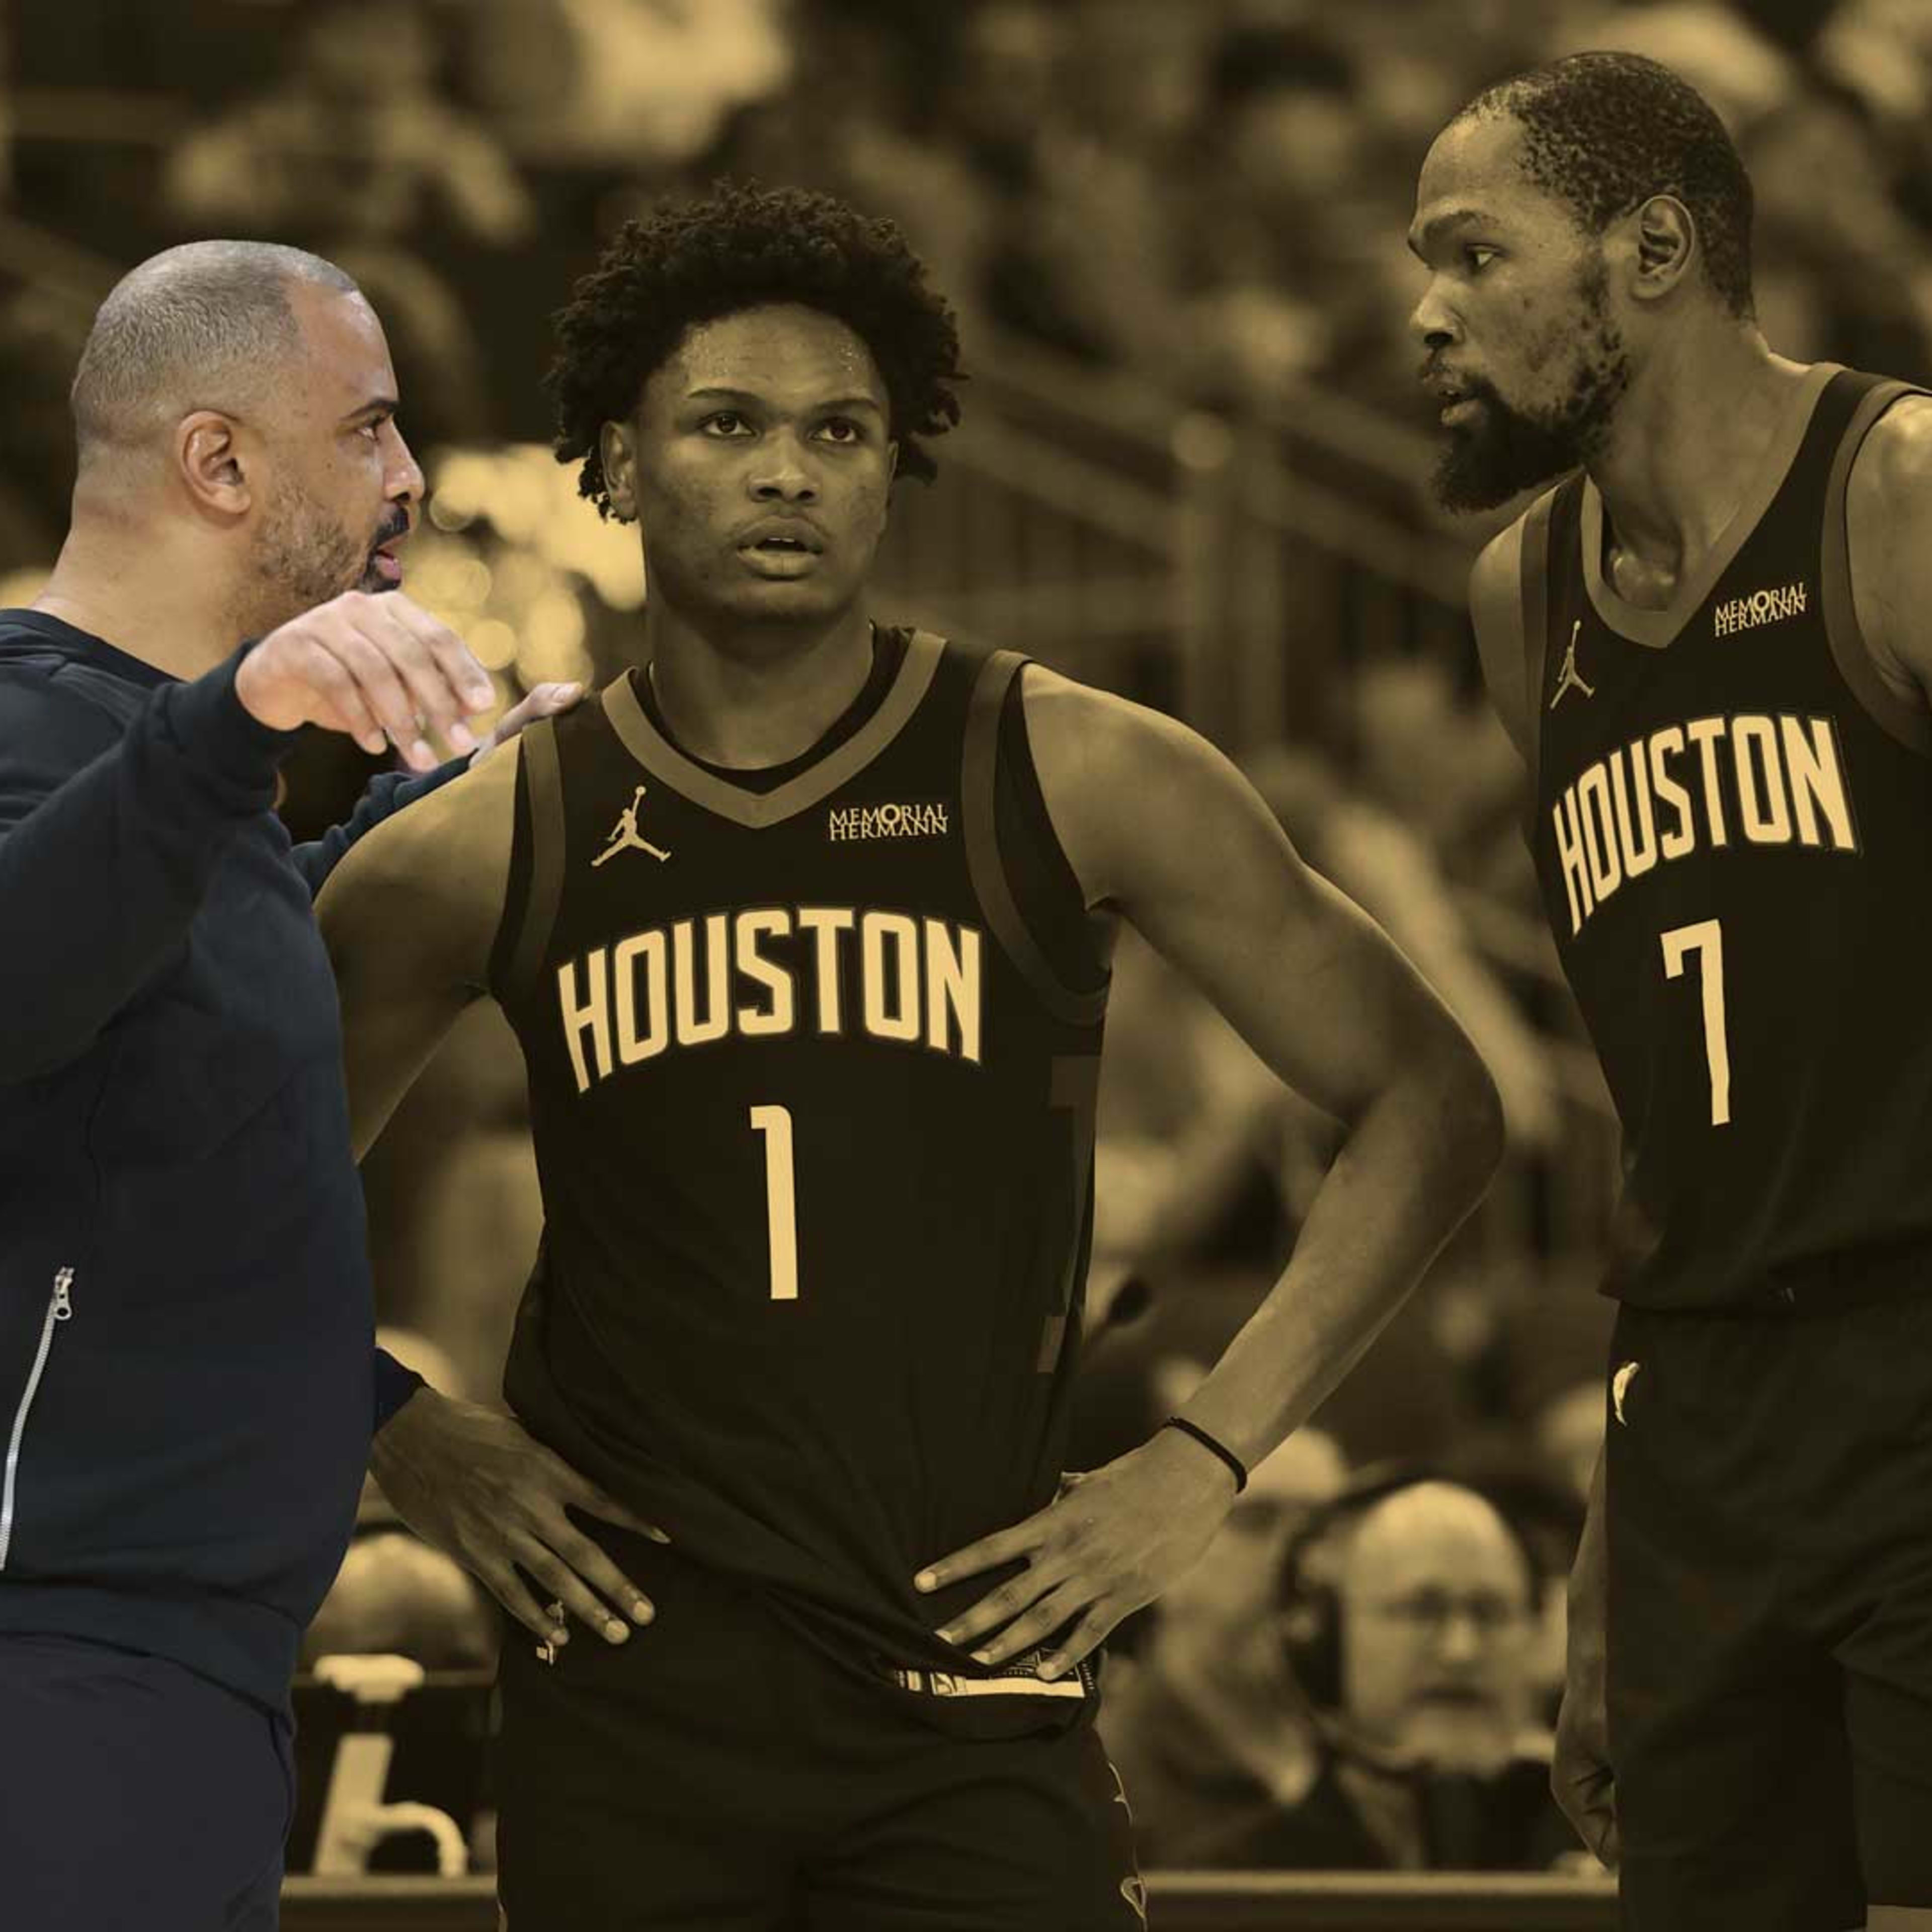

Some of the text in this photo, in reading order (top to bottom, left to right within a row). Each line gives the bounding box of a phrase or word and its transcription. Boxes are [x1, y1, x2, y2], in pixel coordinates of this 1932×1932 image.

[1715, 582, 1807, 620] MEMORIAL
[1715, 597, 1806, 637] HERMANN
[830, 803, 948, 826] MEMORIAL
[830, 818, 947, 841] HERMANN
[1553, 715, 1855, 937] HOUSTON
[557, 907, 982, 1093] HOUSTON
[1661, 919, 1730, 1126] 7
[750, 1105, 798, 1299] 1
